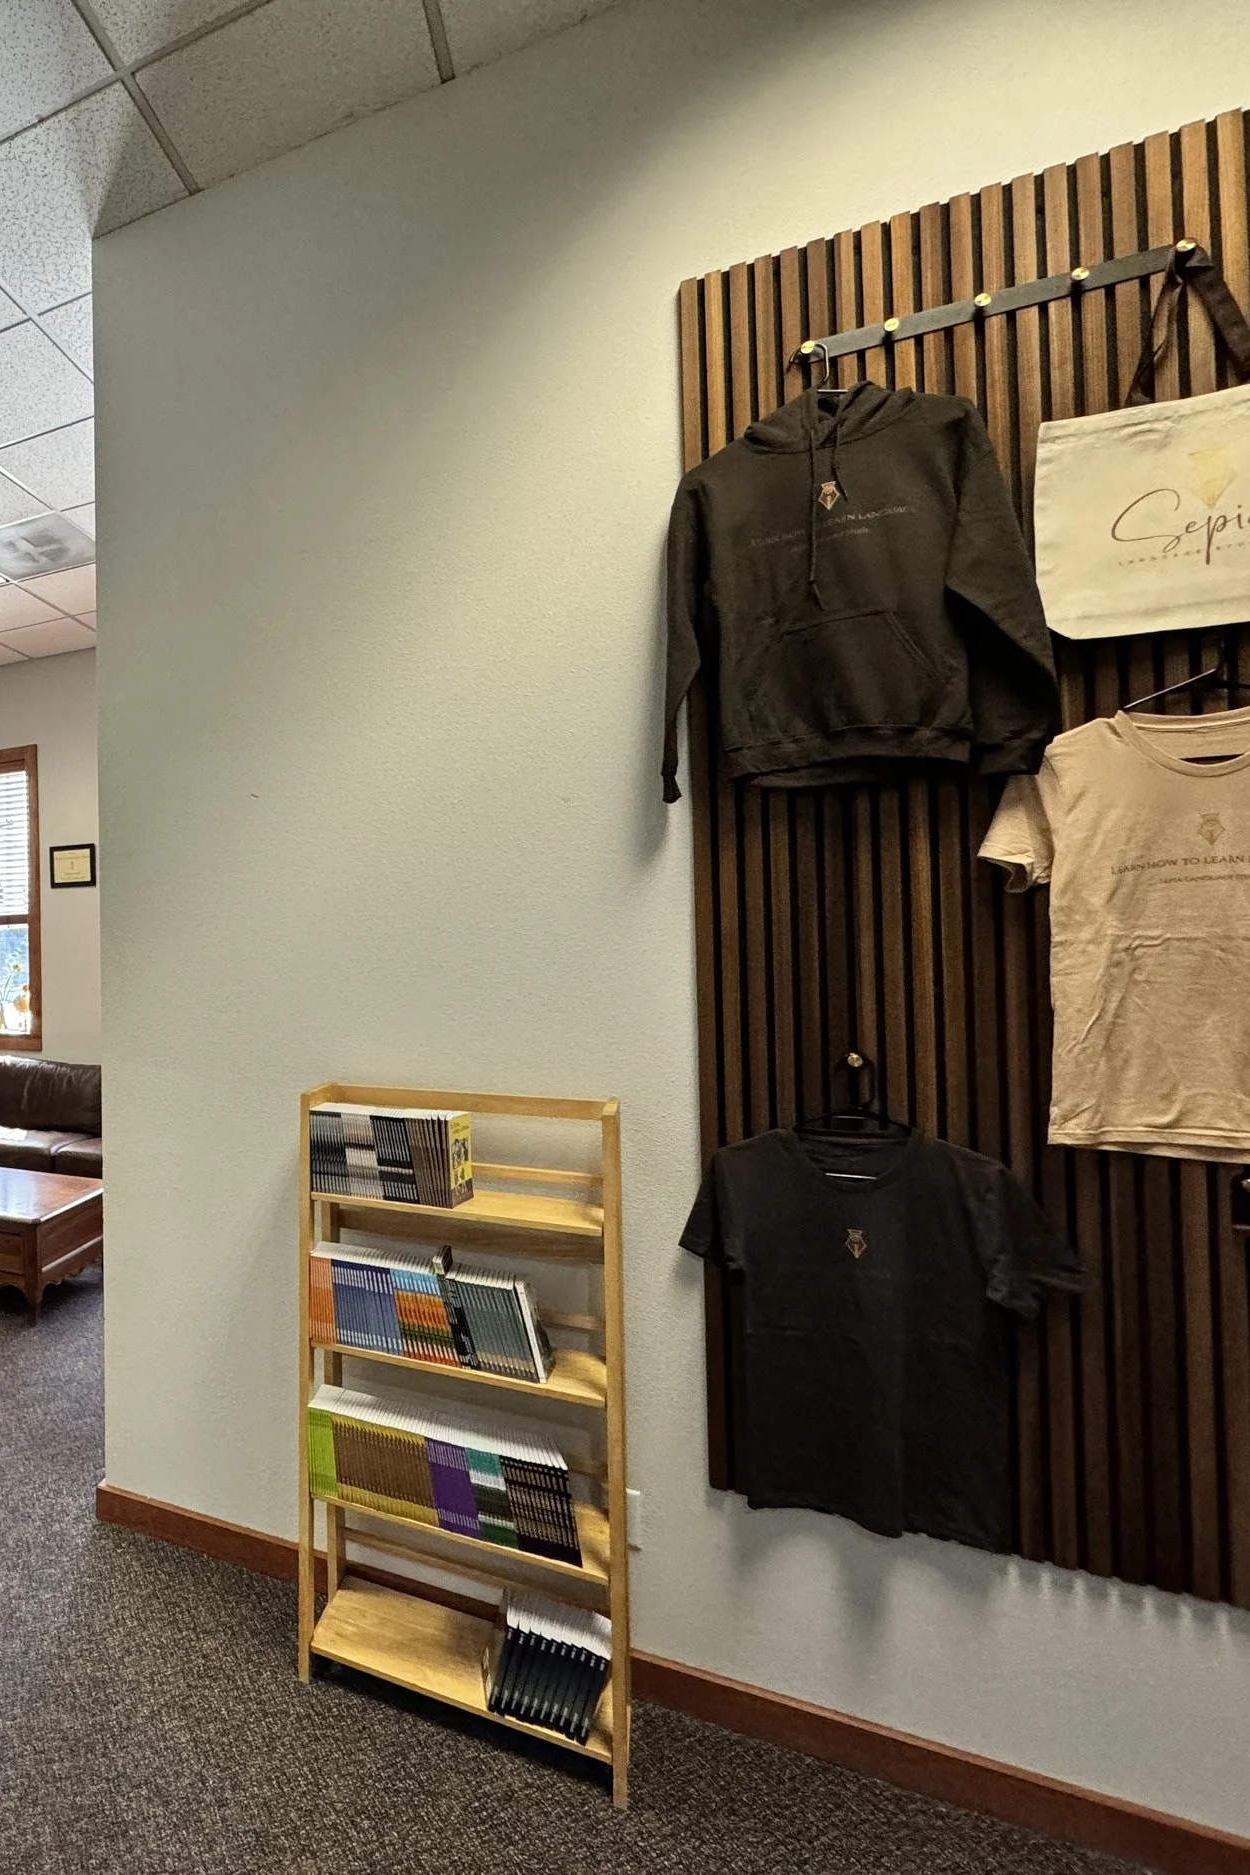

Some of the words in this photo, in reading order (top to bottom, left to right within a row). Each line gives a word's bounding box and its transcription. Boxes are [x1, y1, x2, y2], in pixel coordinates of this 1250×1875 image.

[1111, 488, 1250, 565] Sepi
[1146, 858, 1178, 869] HOW
[1181, 857, 1200, 866] TO
[1204, 854, 1245, 865] LEARN
